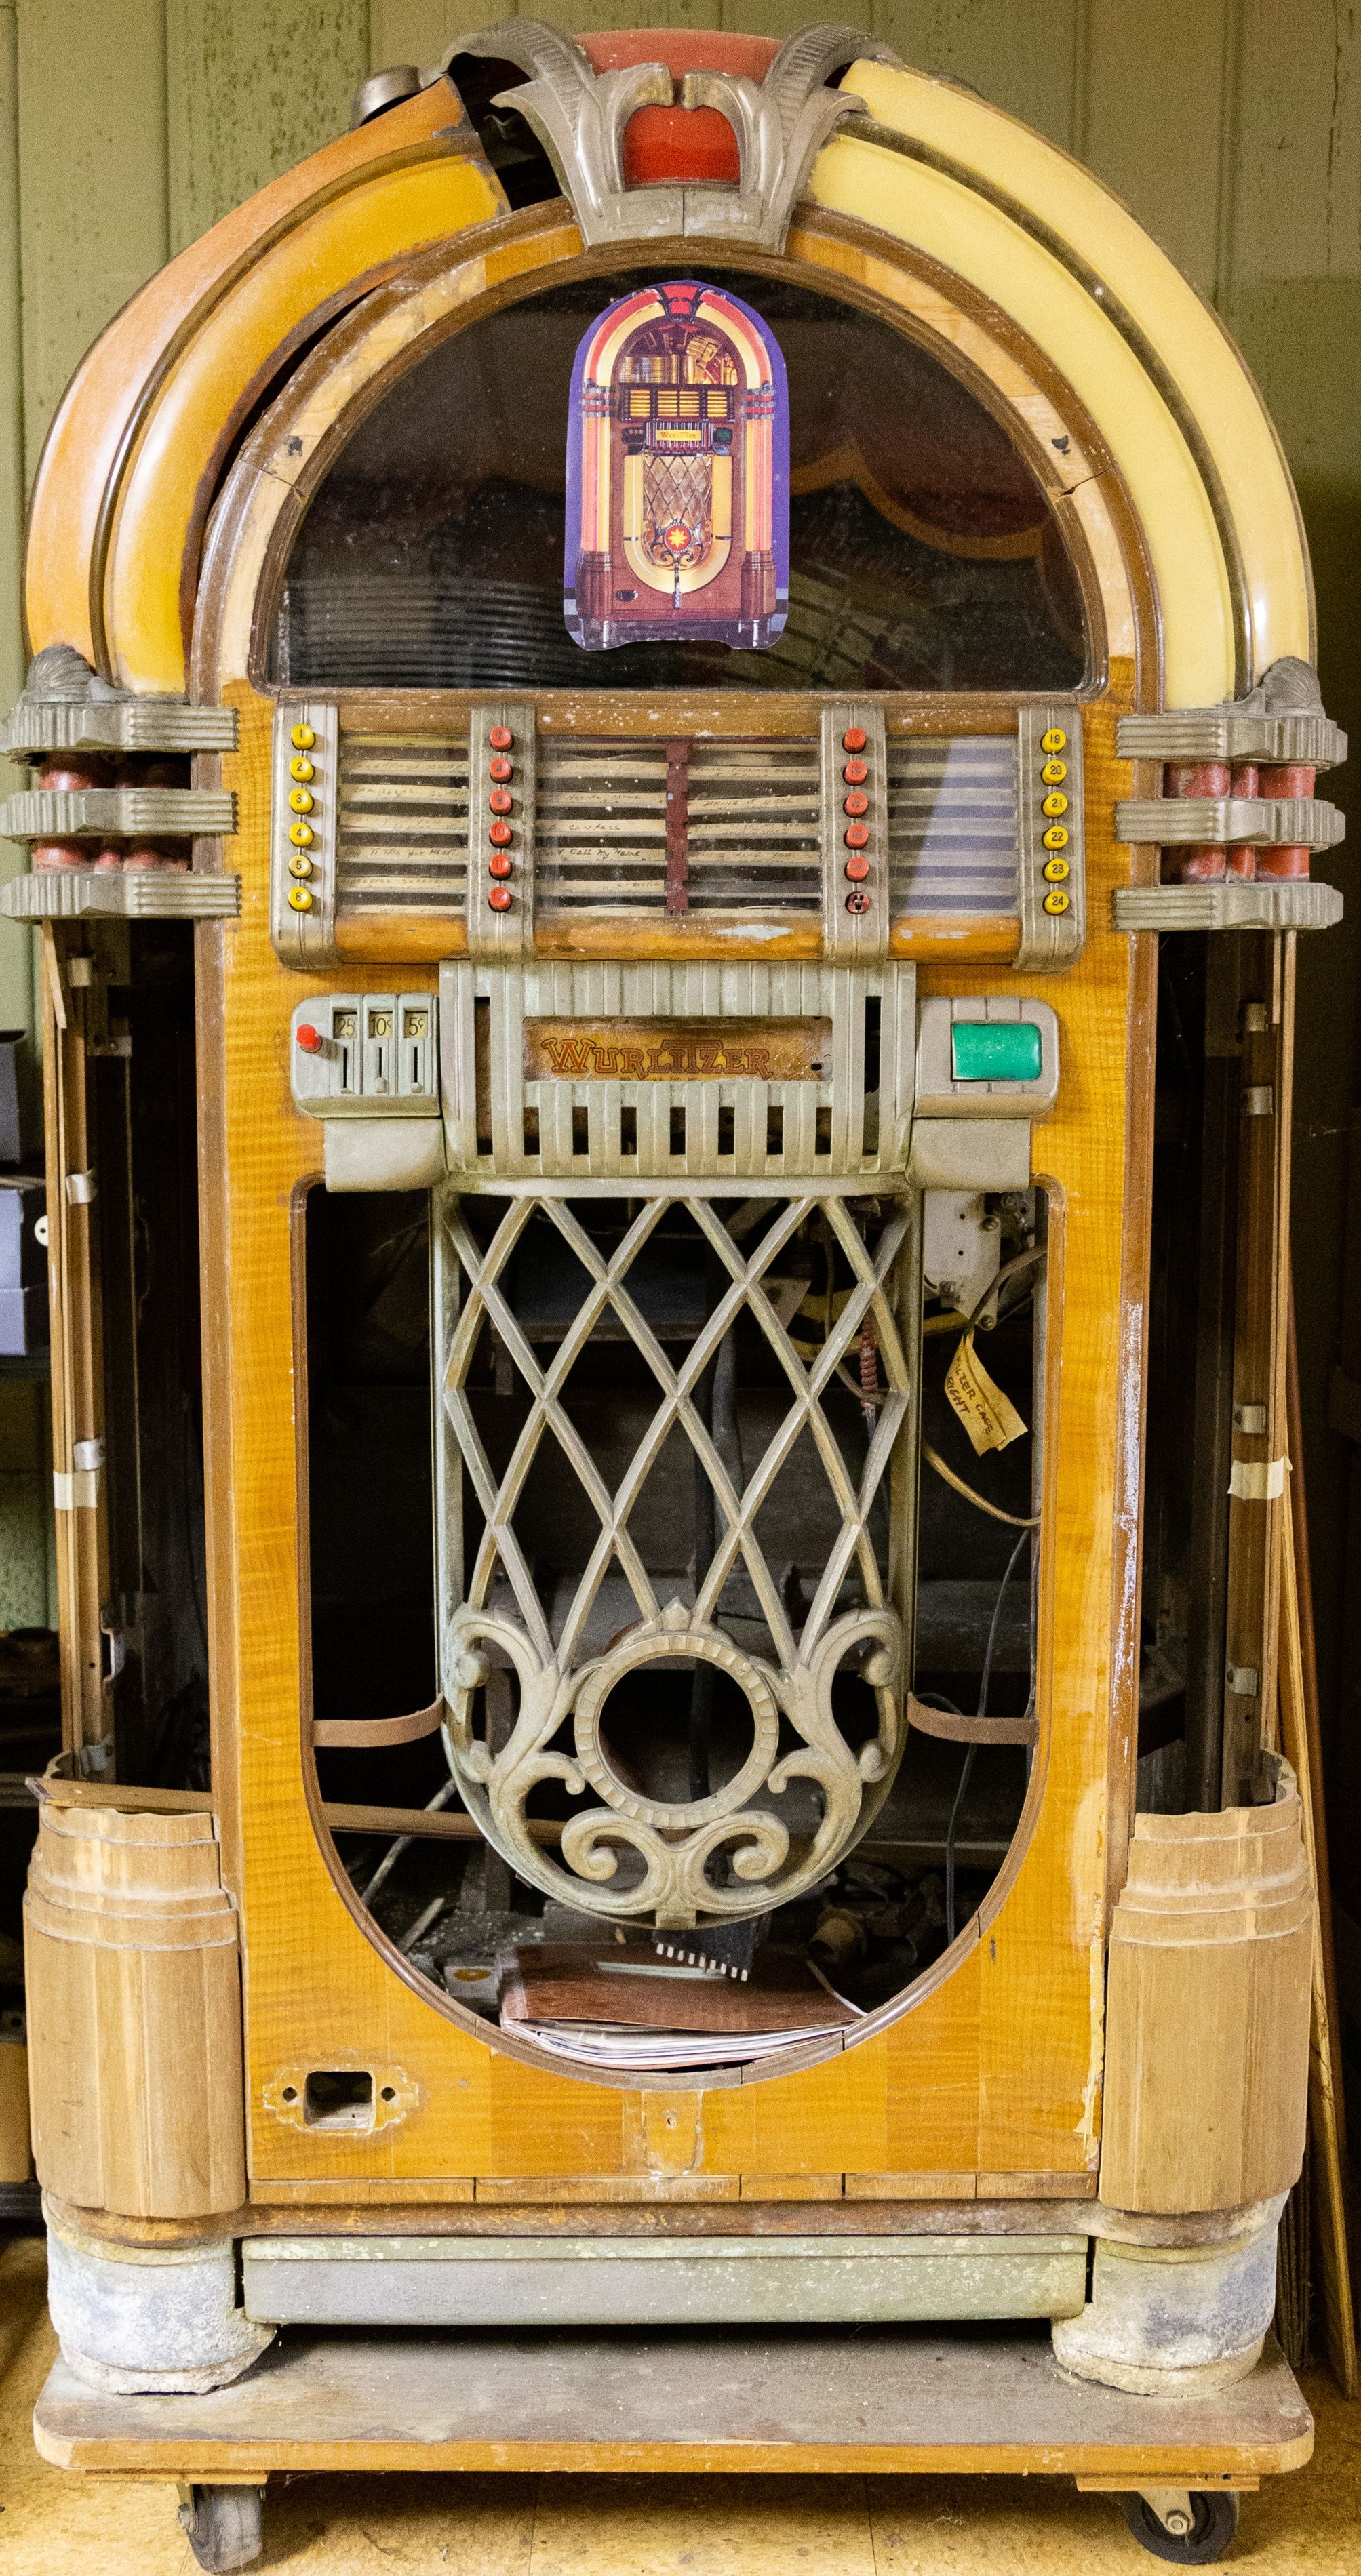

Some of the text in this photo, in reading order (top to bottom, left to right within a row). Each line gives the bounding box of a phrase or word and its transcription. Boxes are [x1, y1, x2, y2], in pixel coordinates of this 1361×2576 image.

[1050, 734, 1061, 744] 19
[296, 761, 303, 771] 2
[496, 764, 502, 772] 8
[1050, 765, 1063, 775] 20
[296, 794, 302, 803] 3
[497, 796, 503, 805] 9
[1052, 798, 1063, 808] 21
[296, 828, 302, 837] 4
[494, 827, 505, 837] 10
[1051, 832, 1063, 841] 22
[296, 860, 302, 870] 5
[1052, 864, 1064, 874] 23
[296, 892, 302, 902] 6
[1052, 896, 1064, 906] 24
[409, 1017, 425, 1036] 5¢
[542, 1037, 774, 1079] WURLITZER
[947, 1377, 971, 1413] RIGHT
